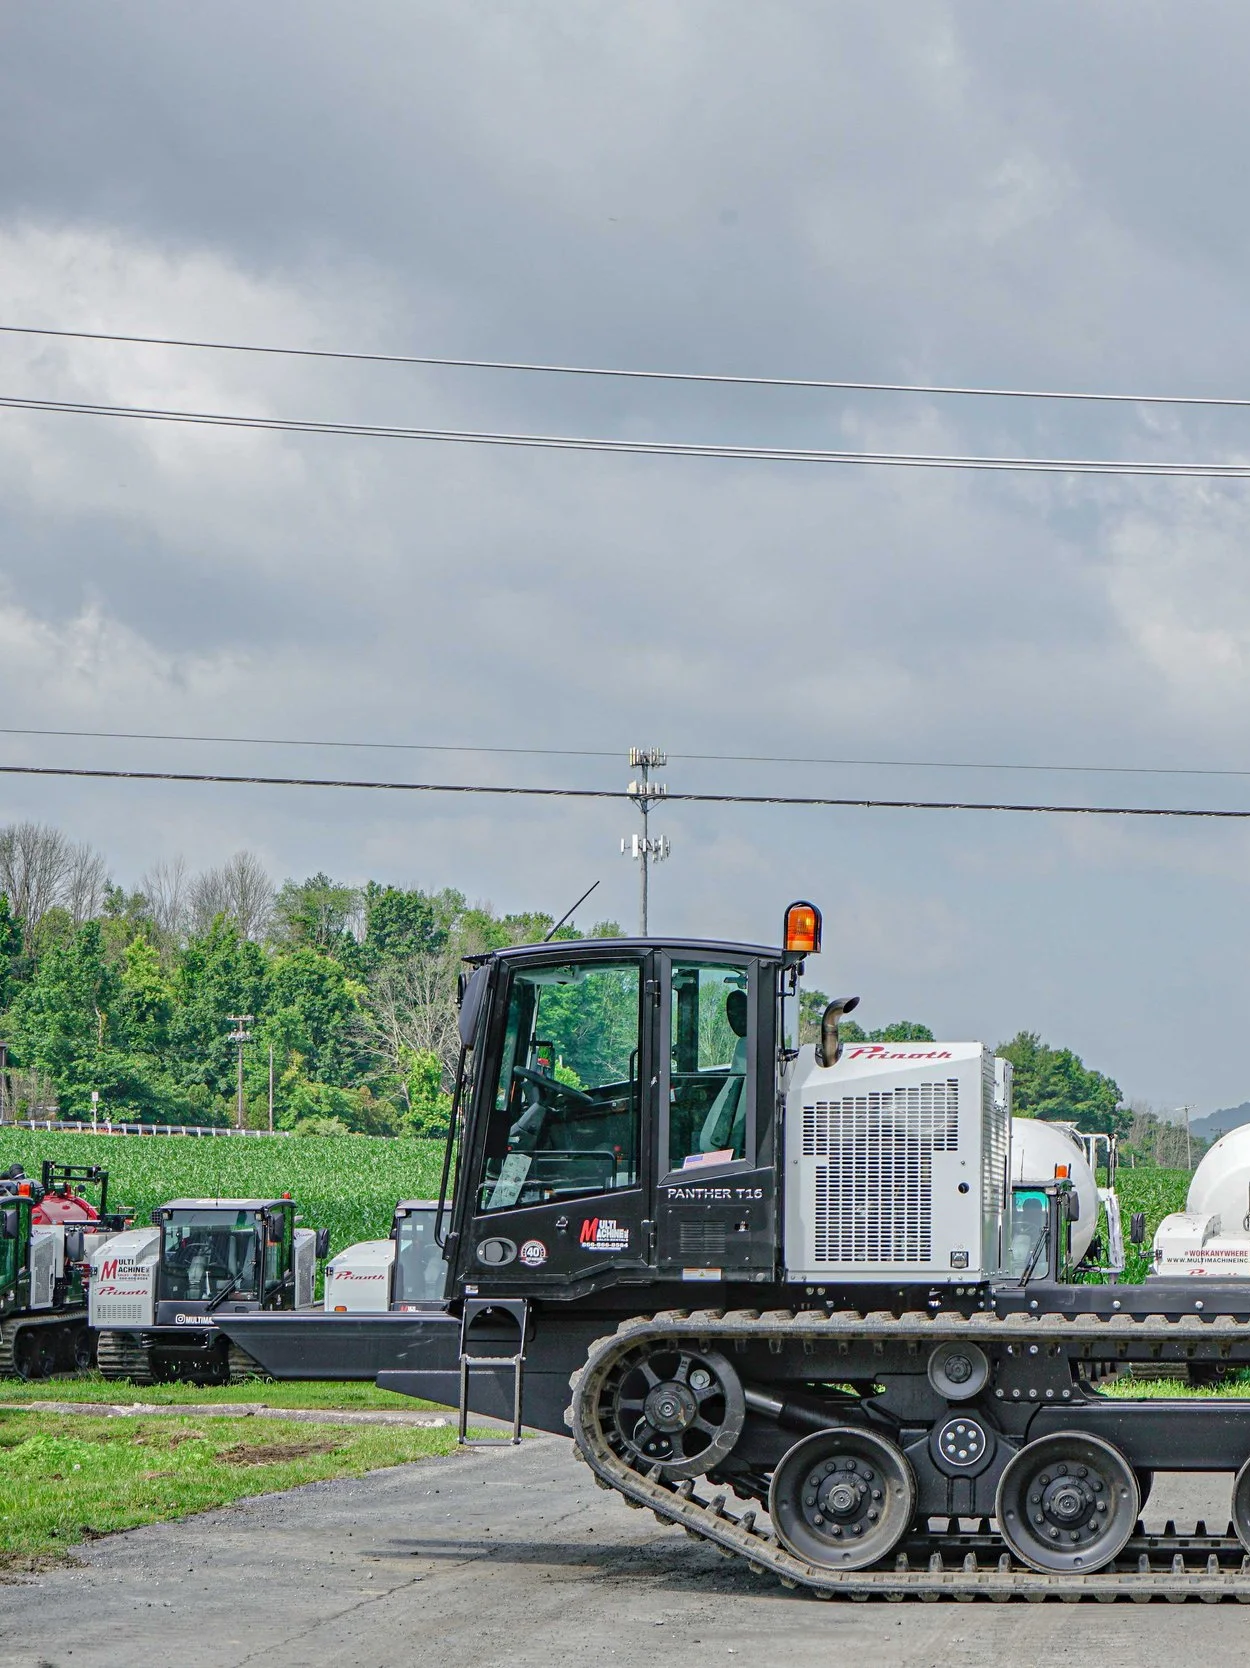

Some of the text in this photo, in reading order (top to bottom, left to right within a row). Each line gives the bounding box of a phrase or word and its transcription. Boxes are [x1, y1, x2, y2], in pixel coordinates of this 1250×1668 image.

[847, 1046, 952, 1059] Prinoth
[667, 1188, 763, 1199] PANTHER T16
[527, 1246, 540, 1257] 40
